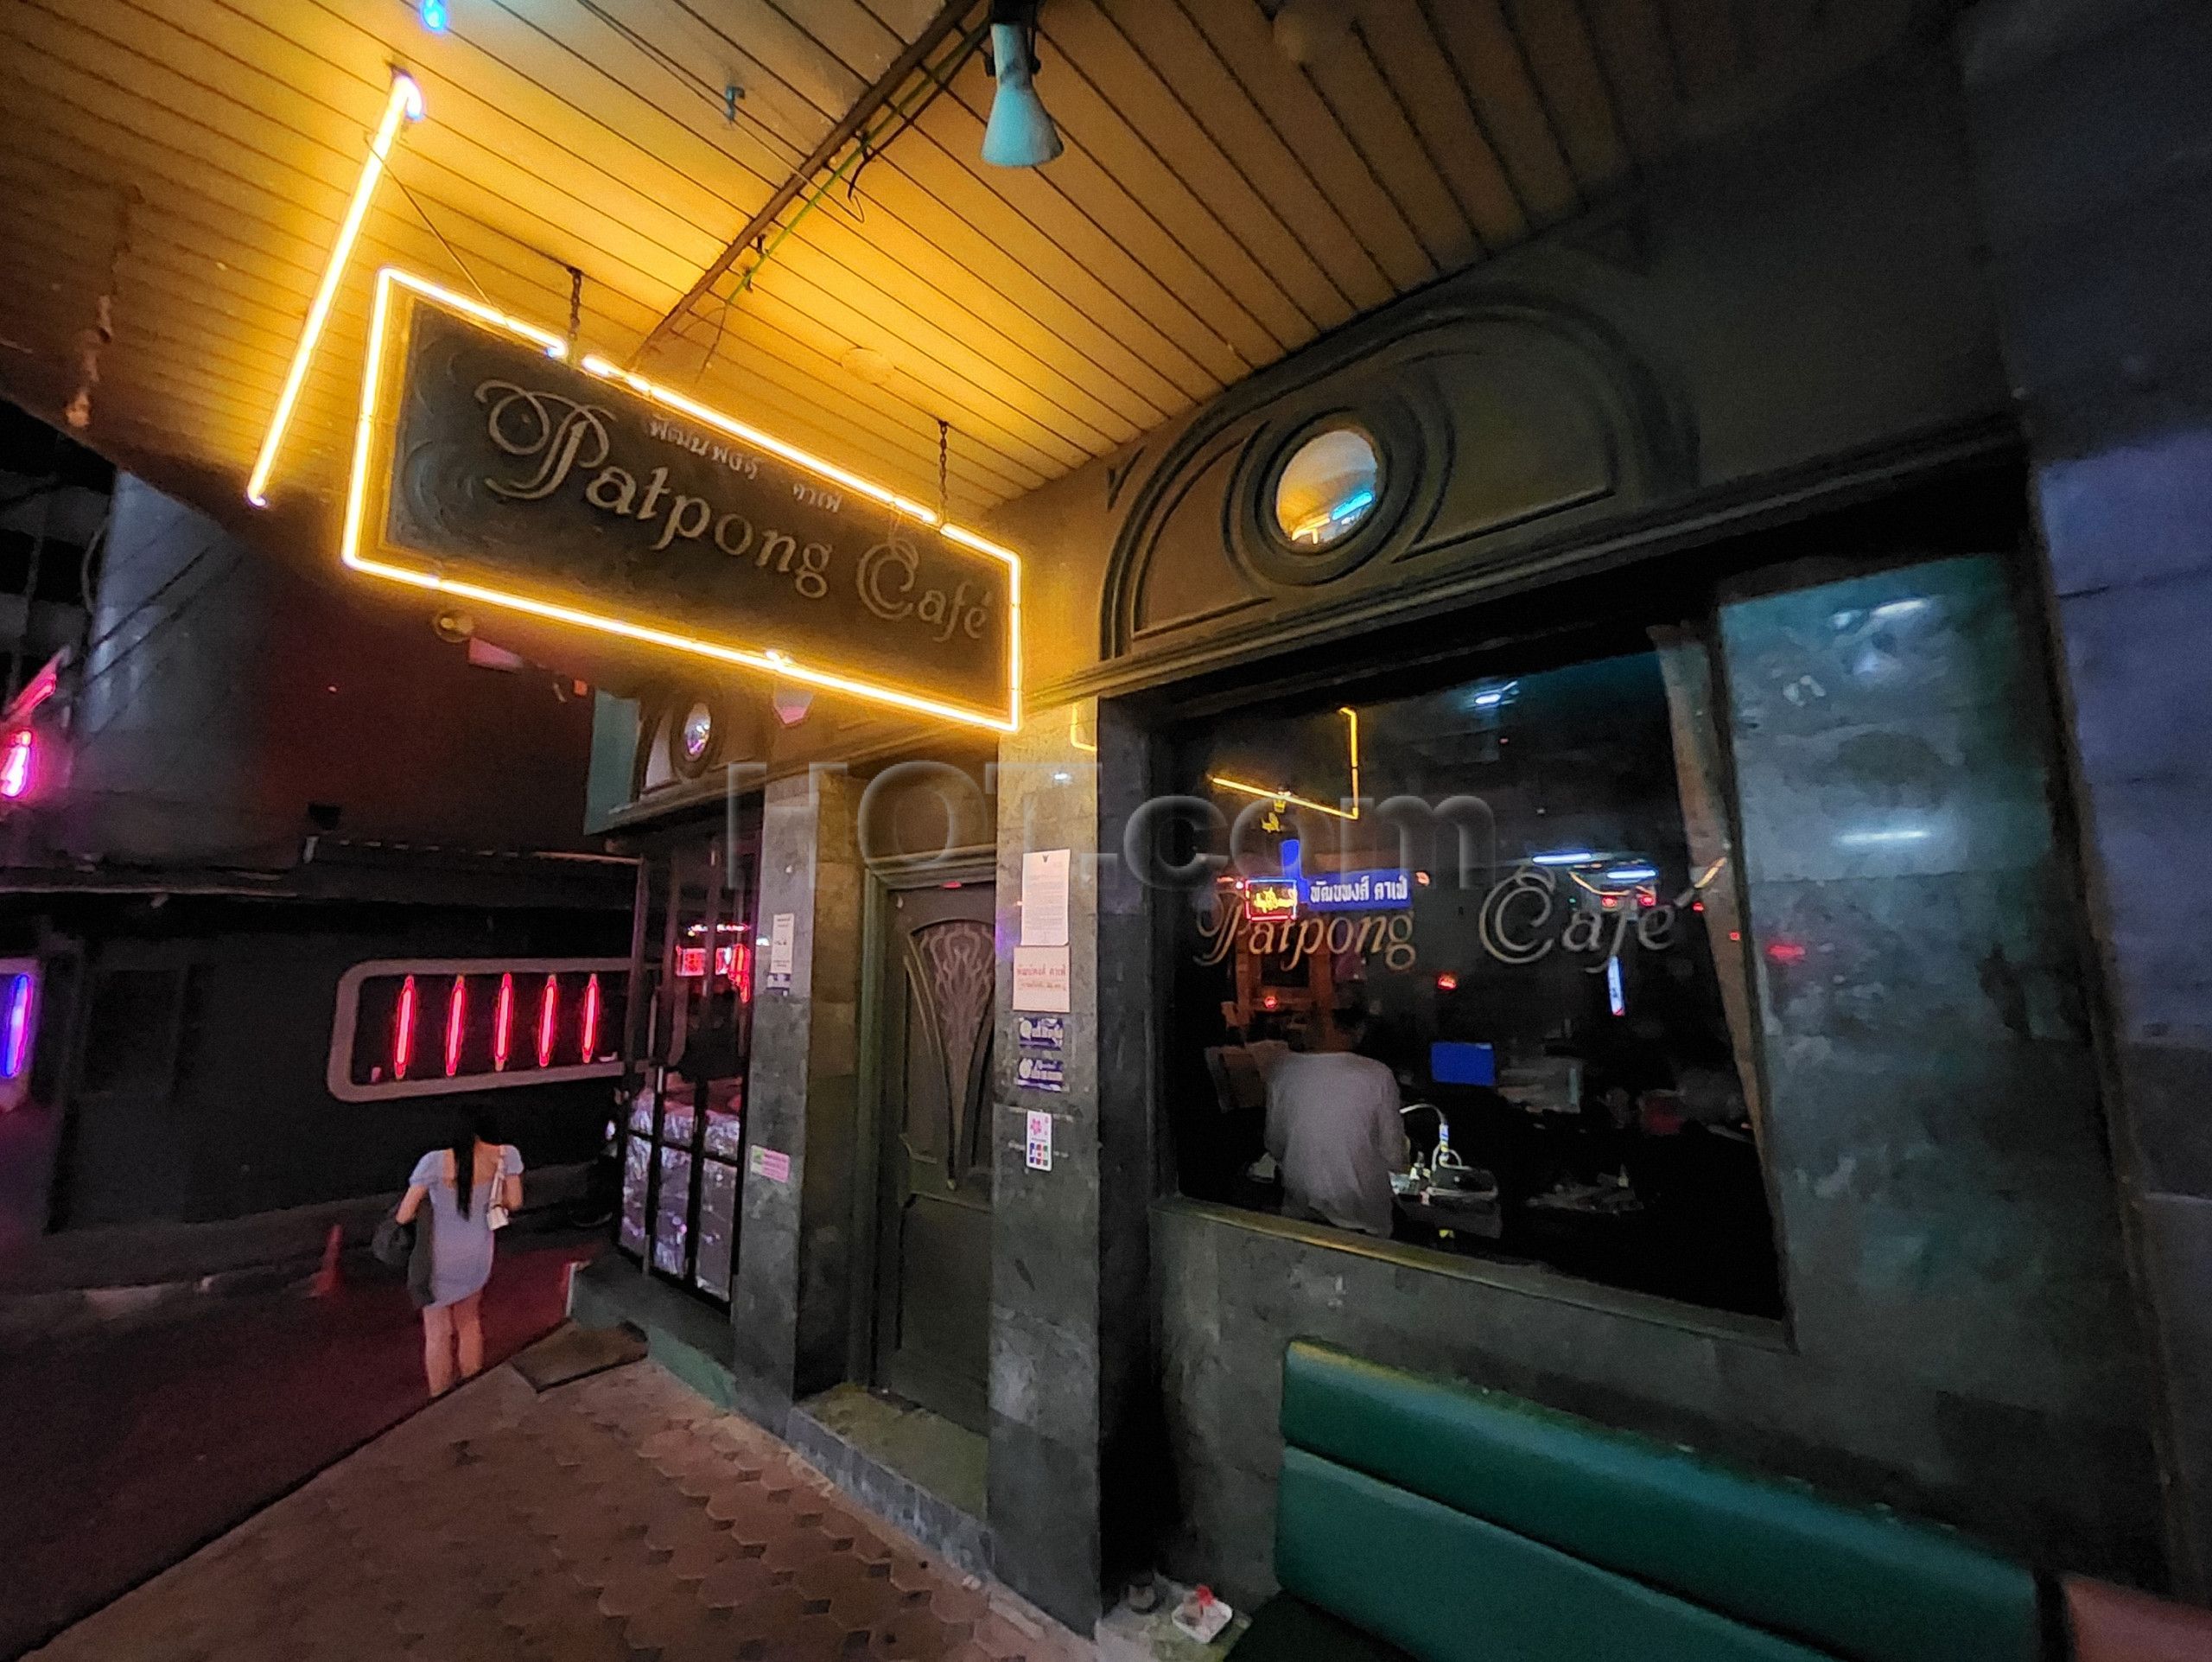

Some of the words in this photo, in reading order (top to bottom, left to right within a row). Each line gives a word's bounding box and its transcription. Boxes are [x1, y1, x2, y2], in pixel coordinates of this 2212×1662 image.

[474, 379, 833, 599] Patpong
[856, 537, 994, 643] Café
[1192, 888, 1417, 971] Patpong
